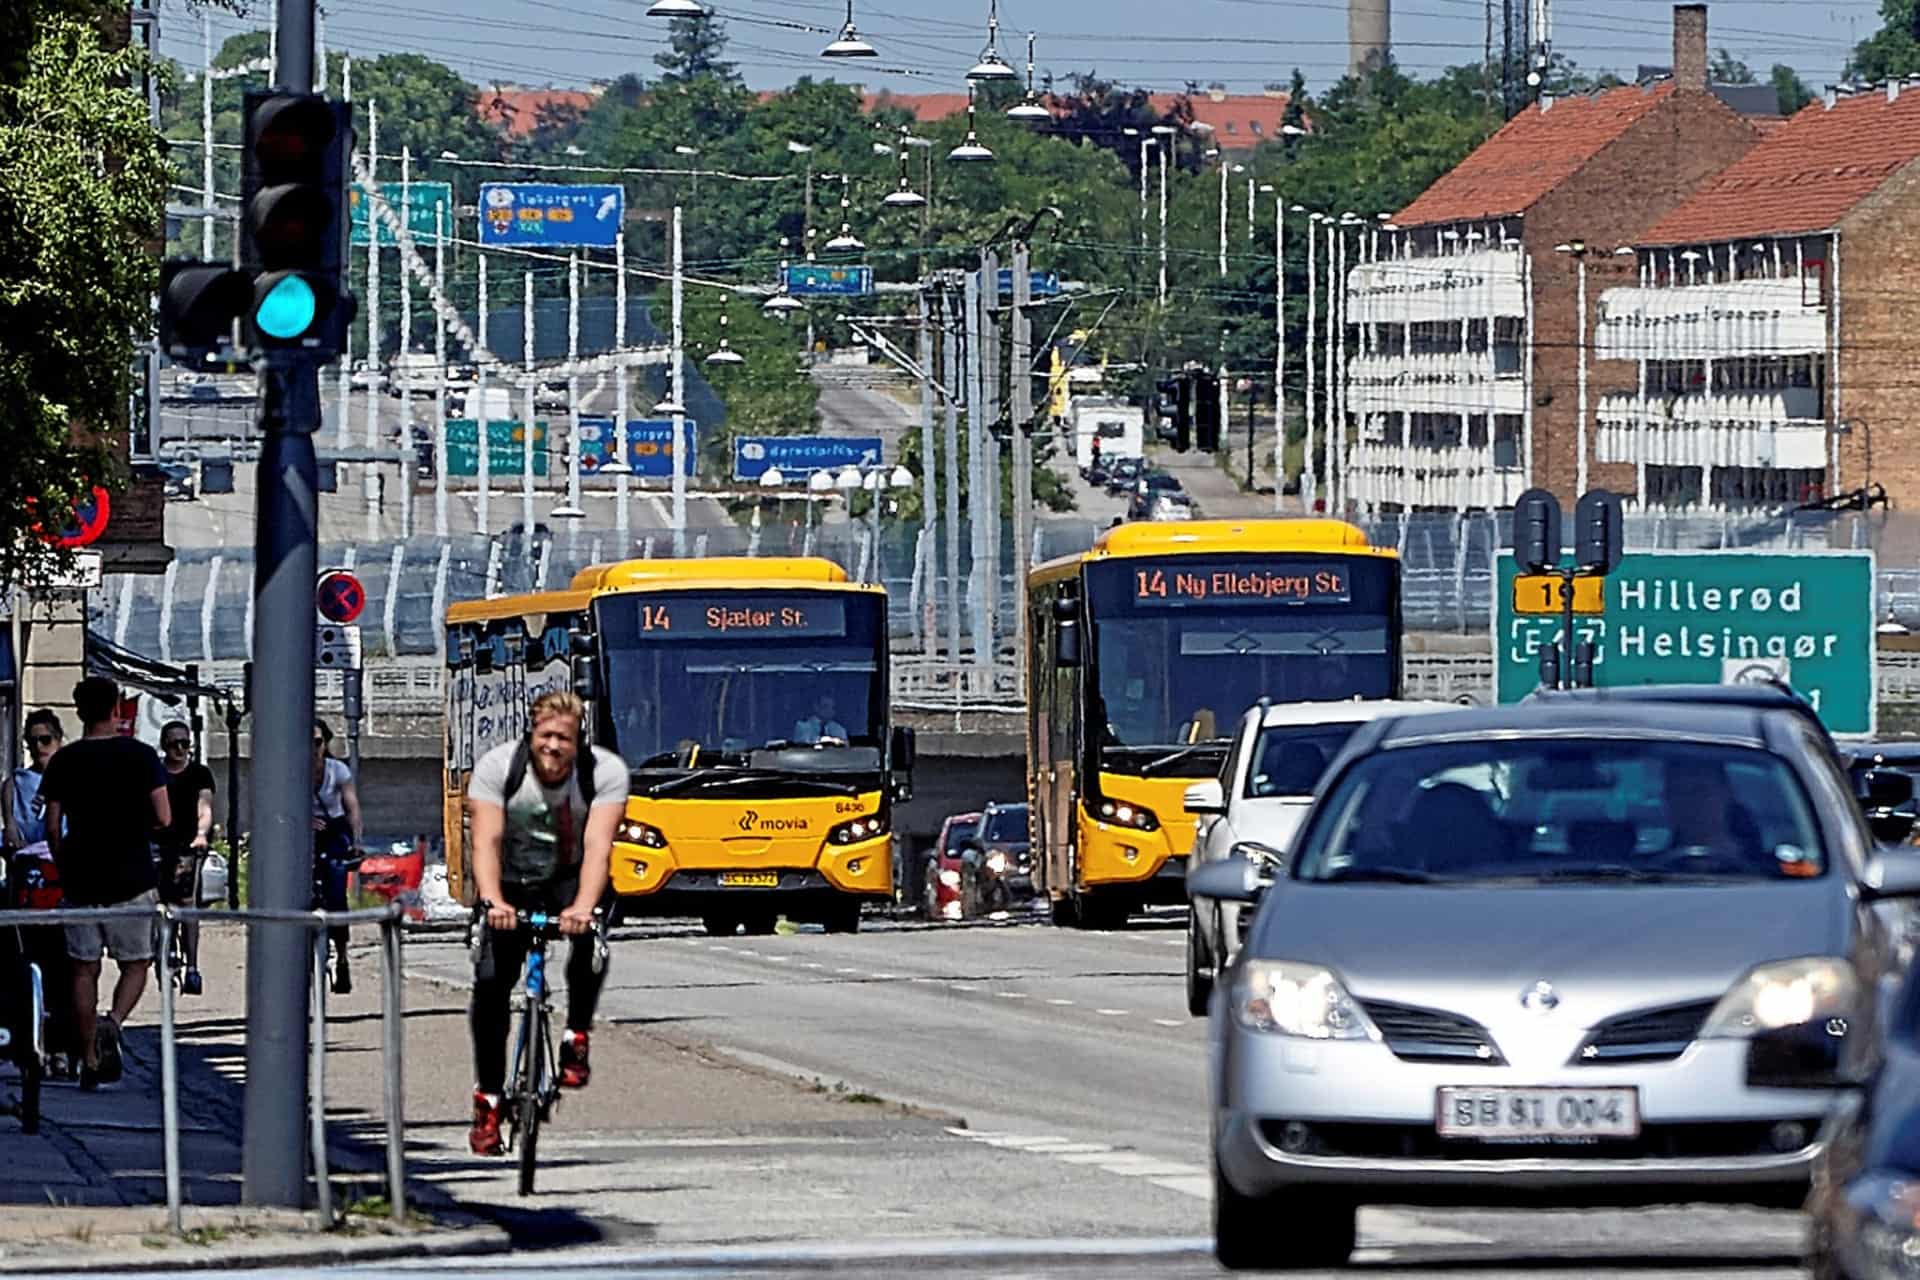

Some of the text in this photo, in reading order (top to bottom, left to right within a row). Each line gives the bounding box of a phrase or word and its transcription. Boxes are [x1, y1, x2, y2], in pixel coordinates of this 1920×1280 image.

[1136, 570, 1345, 599] 14 Ny Ellebjerg St.
[1619, 579, 1801, 612] Hillerød
[643, 606, 671, 631] 14
[781, 607, 809, 627] St.
[760, 817, 808, 830] movia
